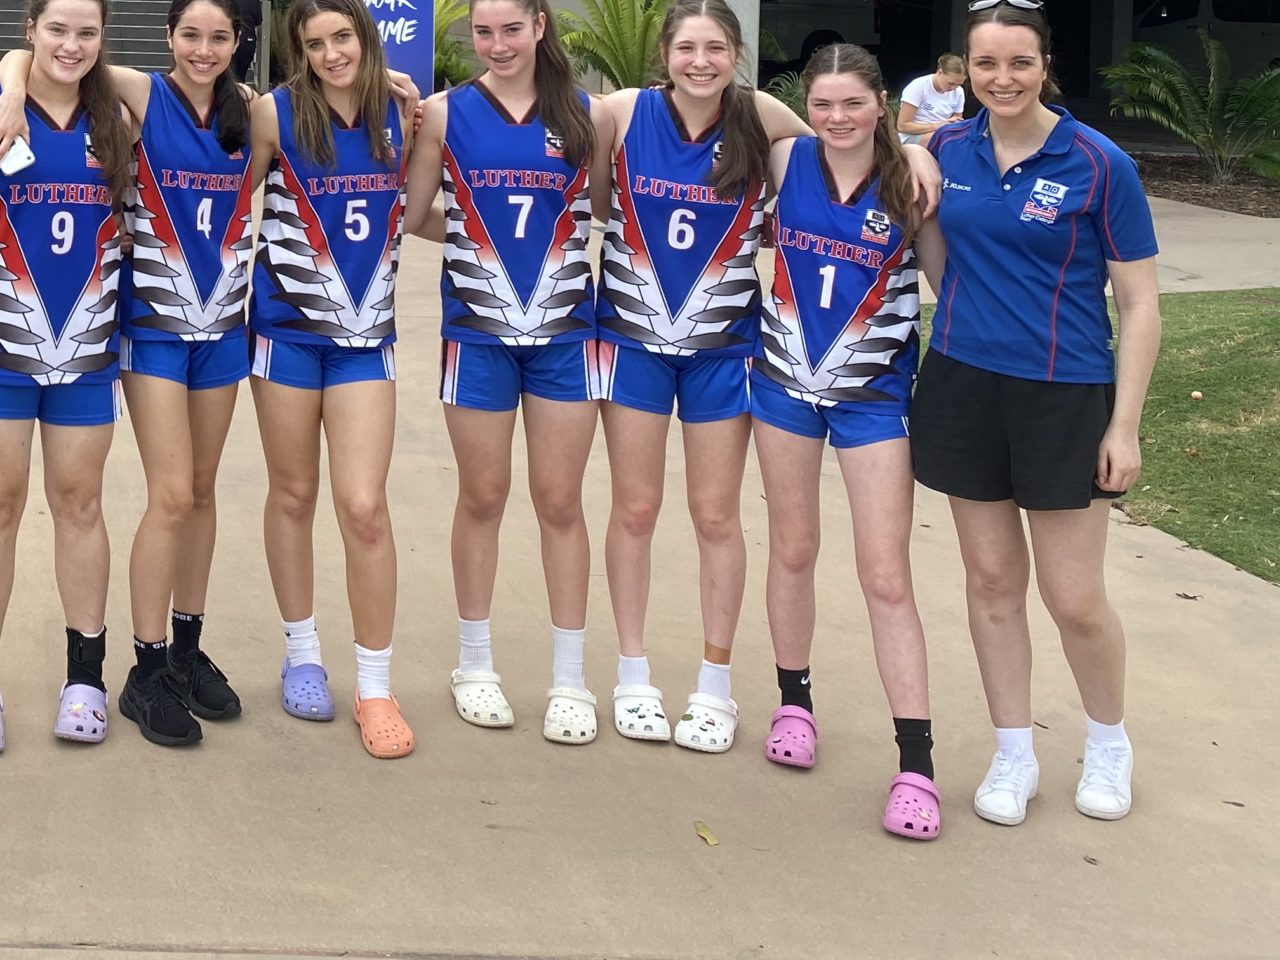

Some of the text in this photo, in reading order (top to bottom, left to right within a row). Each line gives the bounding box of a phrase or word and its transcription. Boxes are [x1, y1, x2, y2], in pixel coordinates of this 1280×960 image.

[378, 17, 419, 45] AME
[9, 183, 113, 206] LUTHER
[307, 173, 399, 196] LUTHER
[50, 210, 75, 255] 9
[196, 197, 213, 240] 4
[343, 199, 371, 242] 5
[508, 195, 534, 238] 7
[667, 208, 696, 250] 6
[780, 227, 884, 269] LUTHER
[818, 265, 837, 309] 1
